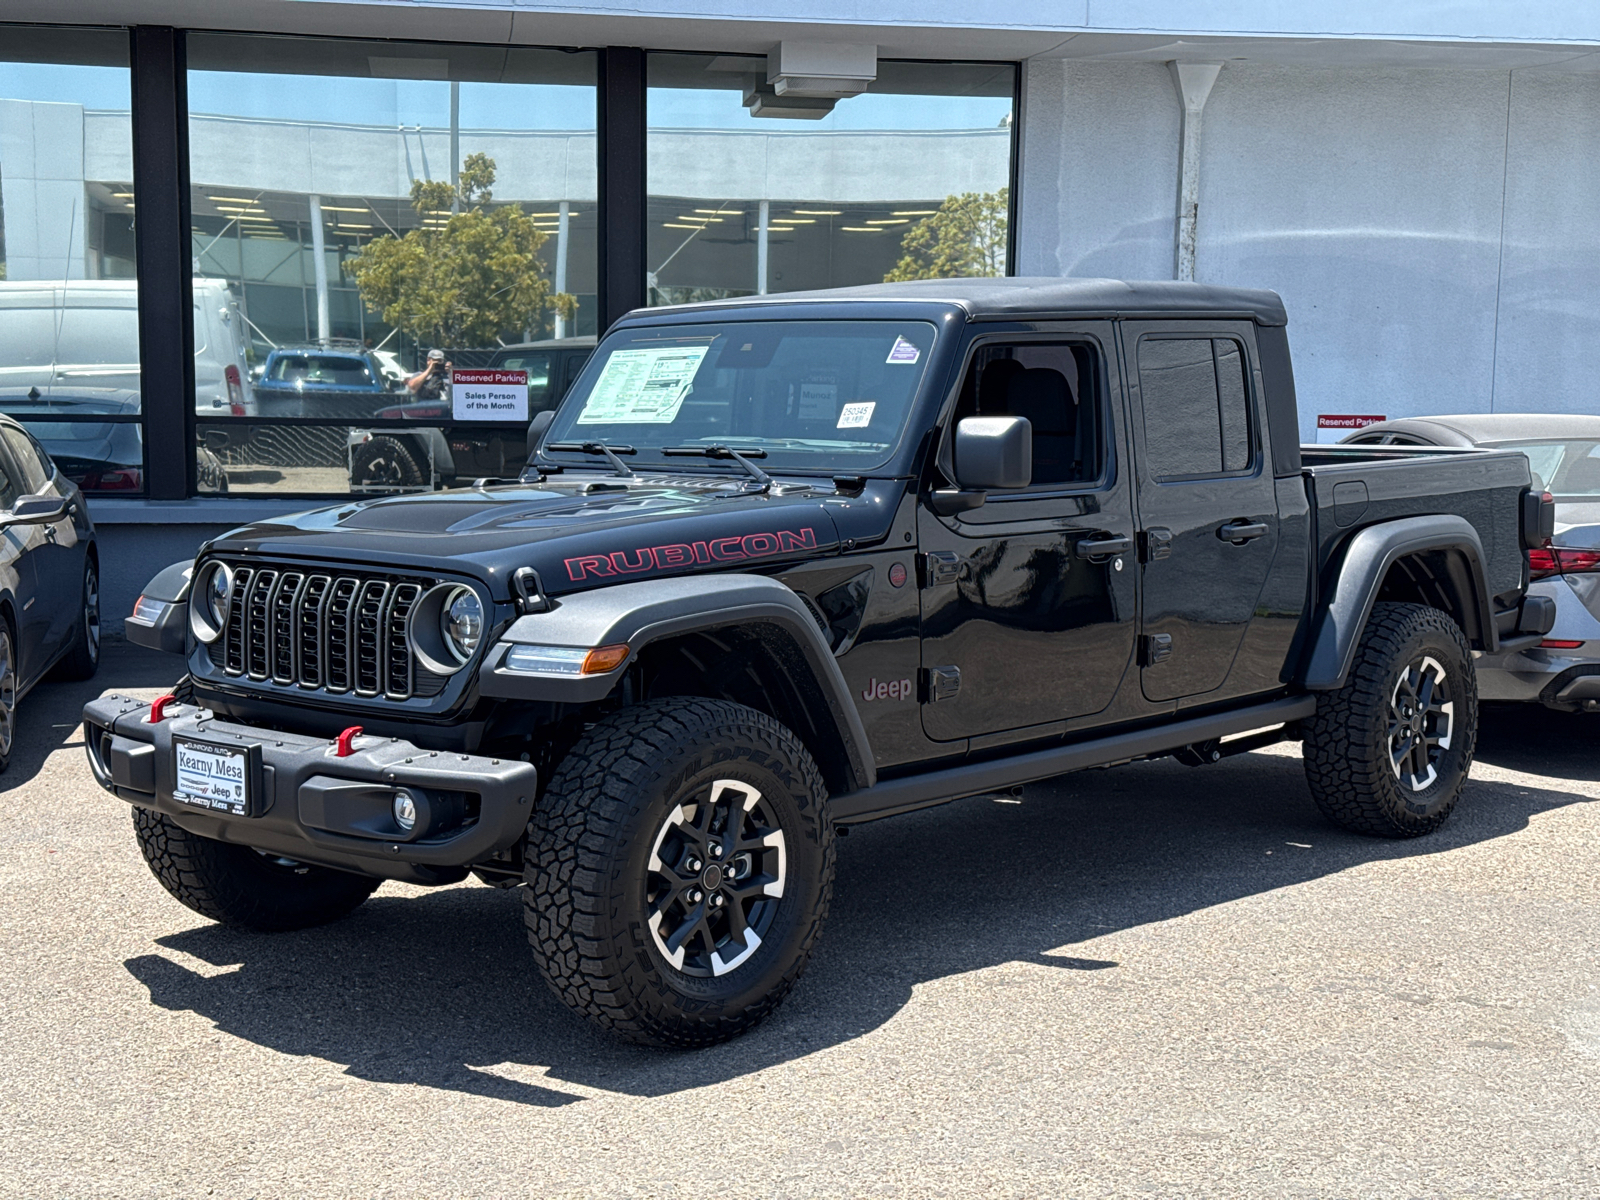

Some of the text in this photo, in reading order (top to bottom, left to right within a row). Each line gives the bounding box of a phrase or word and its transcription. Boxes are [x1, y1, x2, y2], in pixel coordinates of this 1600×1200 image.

[454, 373, 526, 384] Reserved Parking
[465, 392, 516, 400] Sales Person
[490, 402, 515, 410] Month
[1319, 418, 1355, 426] Reserved
[563, 528, 817, 581] RUBICON
[861, 678, 912, 701] Jeep
[179, 751, 243, 778] Kearny Mesa
[211, 784, 231, 799] Jeep
[190, 794, 211, 809] Kearny
[211, 799, 228, 811] Mesa
